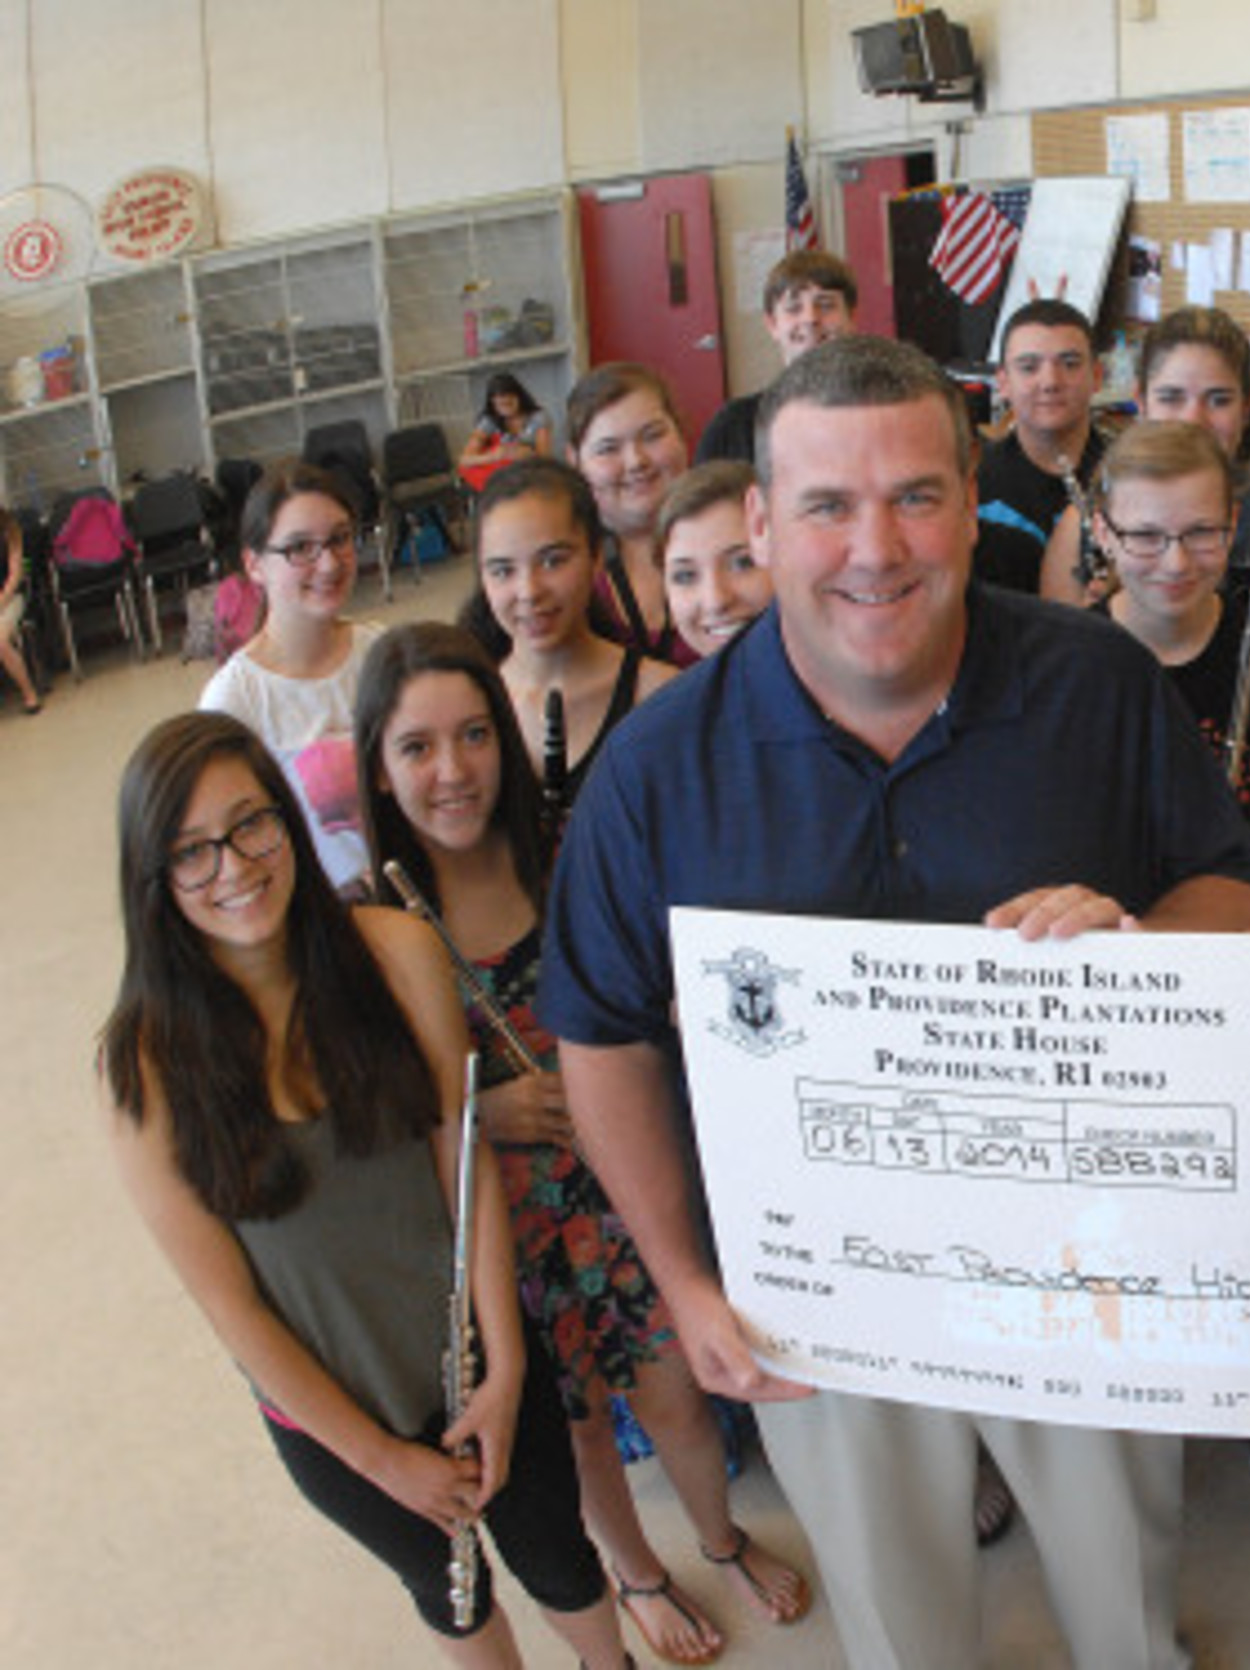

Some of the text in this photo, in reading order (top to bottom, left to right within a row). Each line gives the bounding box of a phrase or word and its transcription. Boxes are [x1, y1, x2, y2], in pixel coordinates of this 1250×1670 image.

[850, 951, 1184, 993] STATE OF RHODE ISLAND
[814, 985, 1229, 1027] AND PROVIDENCE PLANTATIONS
[922, 1021, 1109, 1055] STATE HOUSE
[873, 1048, 1168, 1090] PROVIDENCE, RI 02903
[811, 1122, 867, 1157] 06
[886, 1133, 932, 1166] 13
[954, 1140, 1051, 1172] 2014
